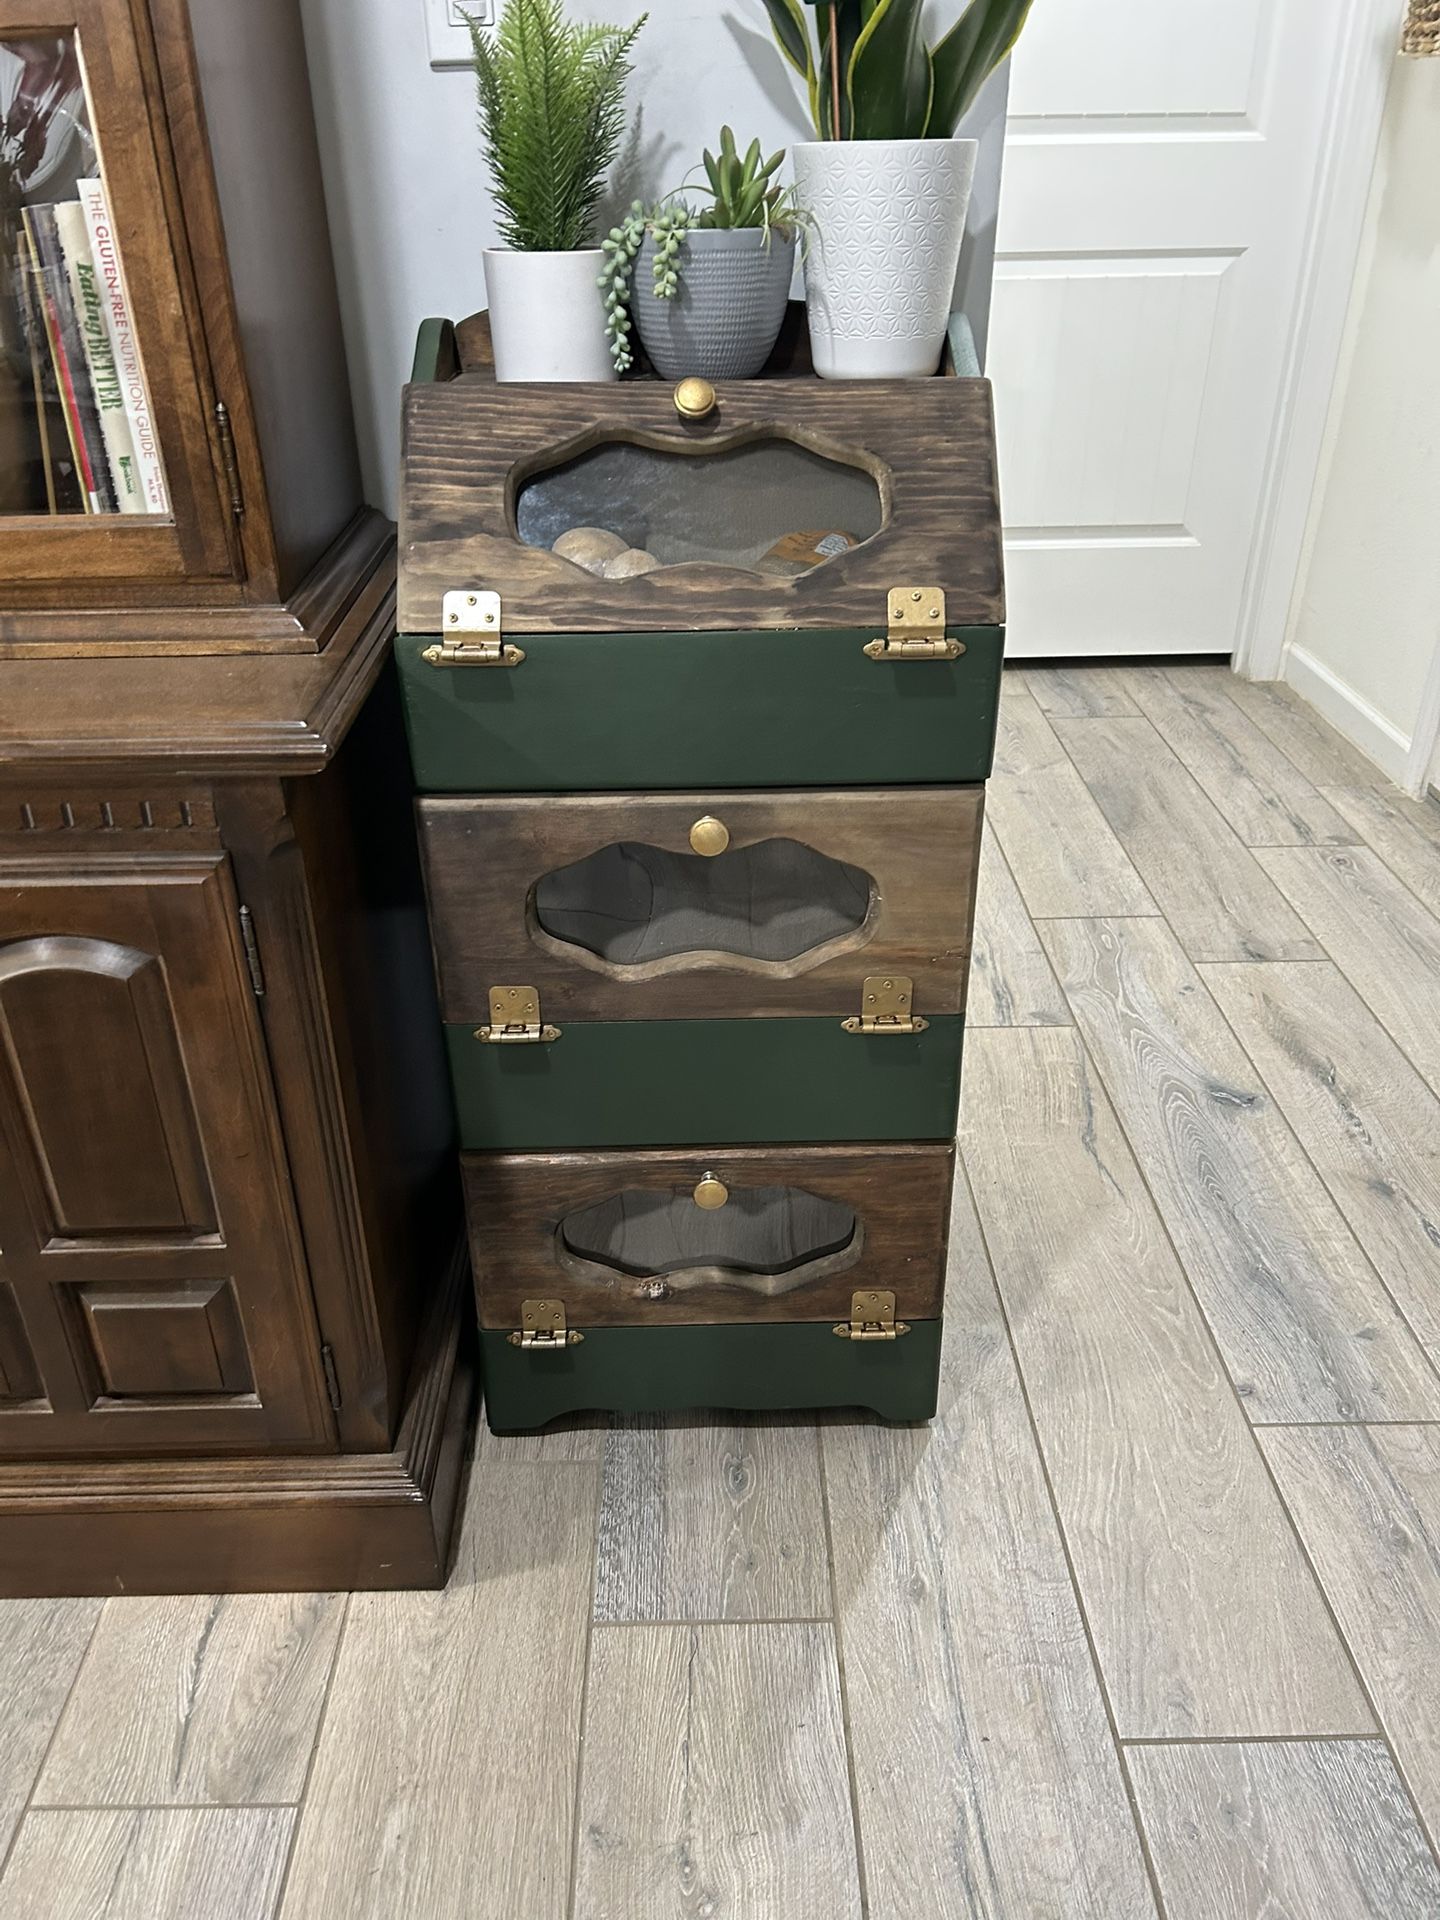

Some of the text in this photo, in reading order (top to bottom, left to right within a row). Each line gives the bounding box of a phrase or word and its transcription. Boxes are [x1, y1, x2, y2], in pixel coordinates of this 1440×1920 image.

[76, 260, 123, 410] Eating BETTER
[88, 192, 156, 459] THE GLUTEN-FREE NUTRITION GUIDE
